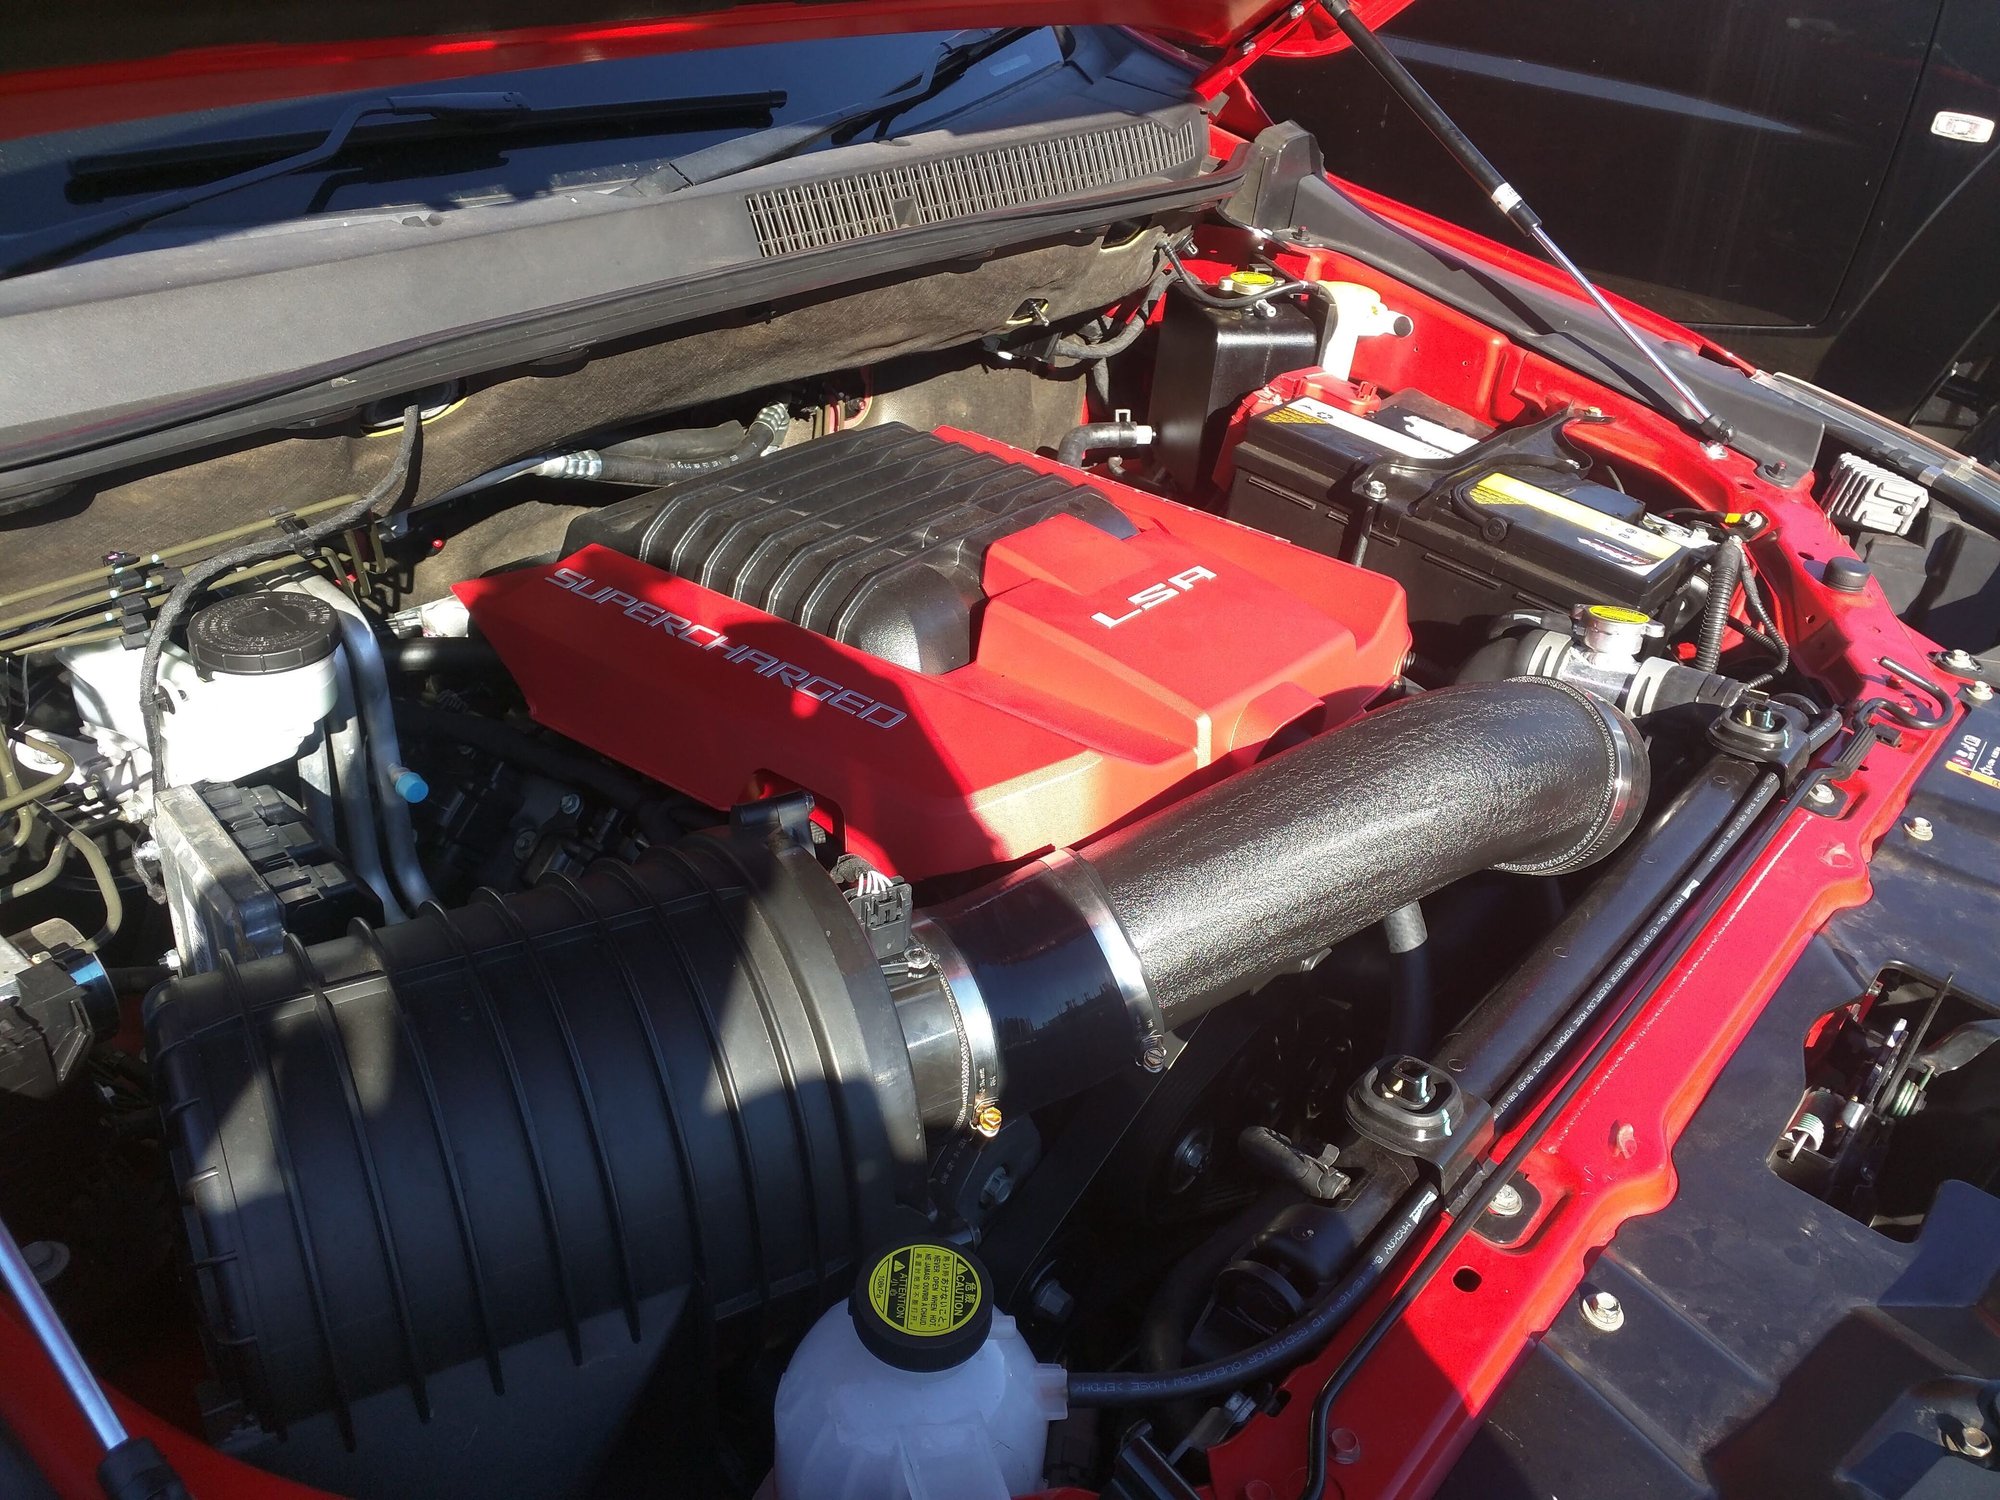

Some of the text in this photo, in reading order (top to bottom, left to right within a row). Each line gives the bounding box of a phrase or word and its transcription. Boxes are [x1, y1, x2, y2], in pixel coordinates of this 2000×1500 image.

[1090, 565, 1217, 629] LSA
[544, 567, 908, 729] SUPERCHARGED
[1610, 956, 1634, 984] RADIATOR
[1587, 982, 1612, 1011] OVERFLOW
[1574, 1010, 1588, 1027] HOSE
[1384, 1222, 1412, 1254] MACKAY
[923, 1262, 931, 1283] JAMAIS
[933, 1255, 941, 1273] NEVER
[896, 1273, 908, 1319] ATTENTION
[954, 1275, 966, 1316] CAUTION
[1248, 1329, 1308, 1364] RADIATOR
[1131, 1381, 1167, 1392] HOSE
